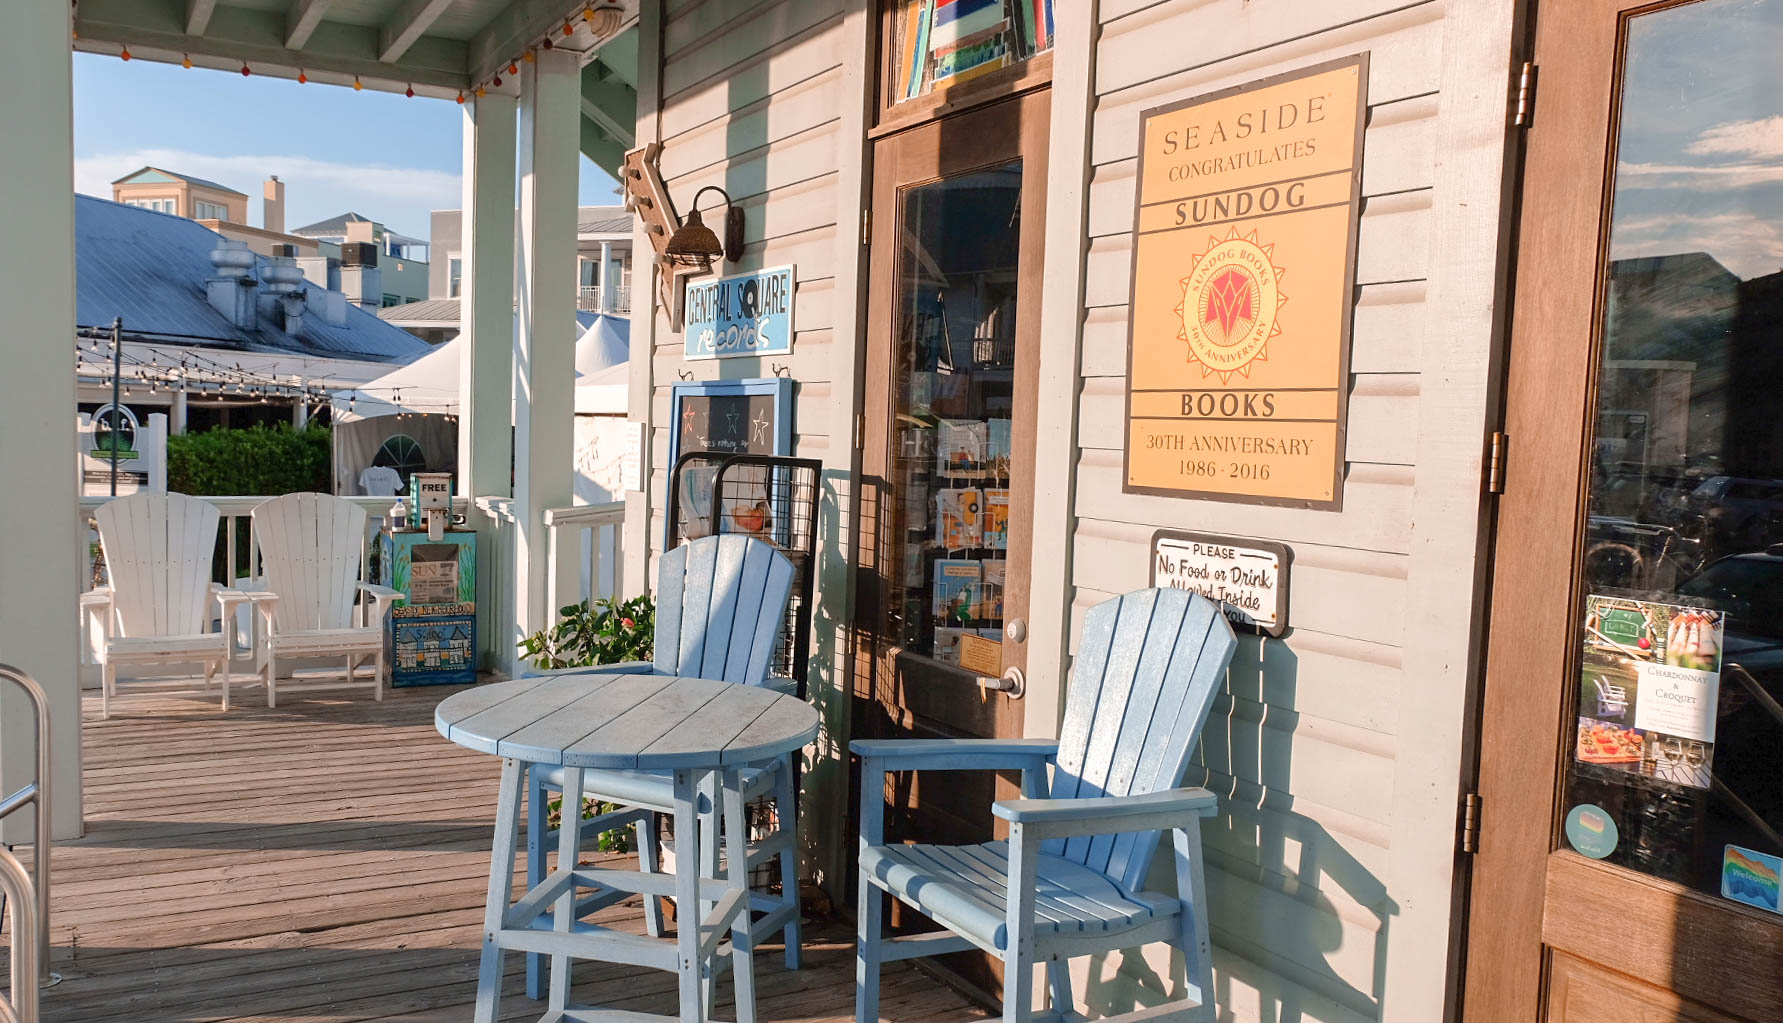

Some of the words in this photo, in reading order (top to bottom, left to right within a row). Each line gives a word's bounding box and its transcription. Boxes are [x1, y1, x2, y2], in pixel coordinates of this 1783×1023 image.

[1163, 95, 1326, 155] SEASIDE
[1168, 138, 1316, 182] CONGRATULATES
[1175, 182, 1305, 225] SUNDOG
[1193, 248, 1235, 293] SUNDOG
[1239, 248, 1270, 287] BOOKS
[689, 283, 732, 326] CENTRAL
[737, 273, 787, 319] SQUARE
[697, 315, 771, 353] records
[1204, 320, 1268, 364] ANNIVERSARY
[1181, 393, 1275, 417] BOOKS
[1146, 434, 1185, 450] 30TH
[1189, 436, 1314, 456] ANNIVERSARY
[1179, 459, 1216, 477] 1986
[1229, 462, 1270, 481] 2016
[421, 483, 447, 492] FREE
[1193, 544, 1236, 560] PLEASE
[1159, 555, 1175, 574] No
[1179, 559, 1209, 580] Food
[1214, 569, 1227, 582] or
[1231, 566, 1273, 589] Drink
[1218, 586, 1260, 610] Inside
[1672, 682, 1679, 690] &
[1731, 868, 1774, 887] Welcome
